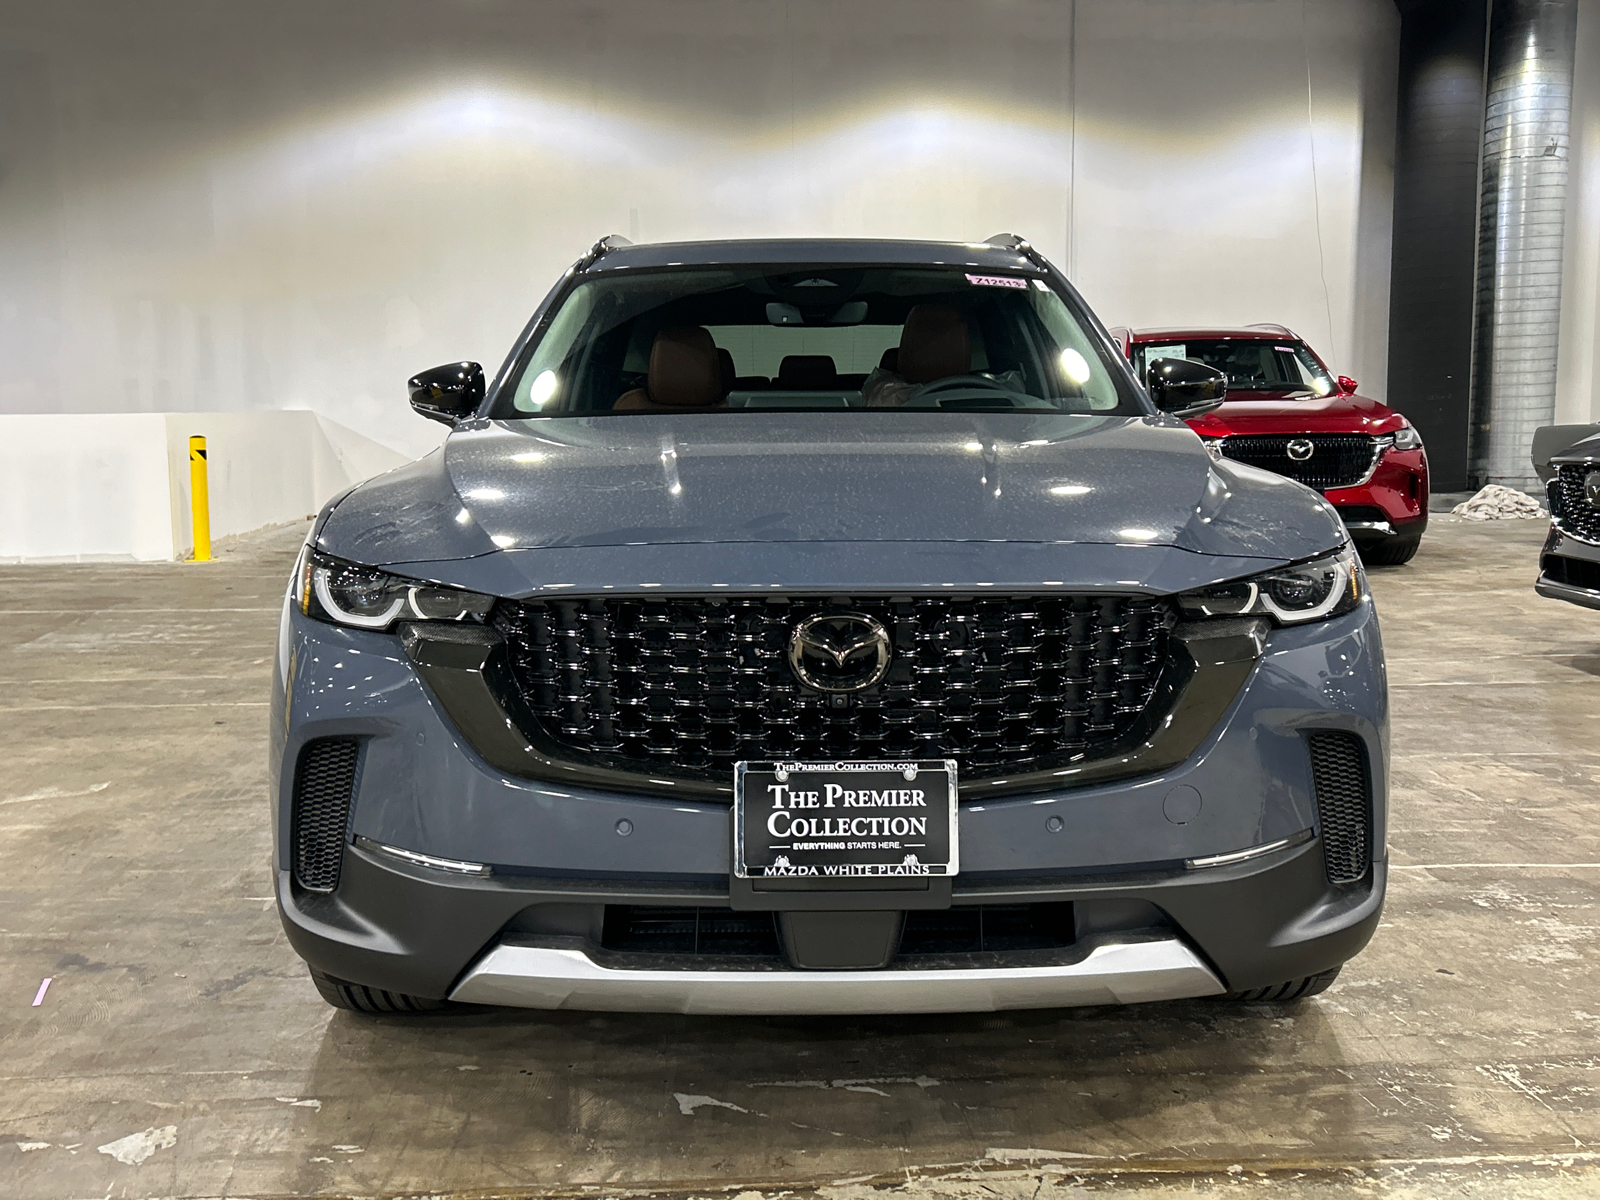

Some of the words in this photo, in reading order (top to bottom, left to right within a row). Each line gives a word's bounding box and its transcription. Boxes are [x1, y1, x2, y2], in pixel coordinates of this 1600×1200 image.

[773, 762, 919, 771] THEPREMIERCOLLECTION.COM
[767, 784, 820, 809] THE
[823, 783, 927, 808] PREMIER
[767, 811, 927, 838] COLLECTION
[793, 842, 846, 850] EVERYTHING
[847, 841, 877, 849] STARTS
[878, 841, 902, 849] HERE.
[764, 865, 819, 876] MAZDA
[823, 865, 872, 876] WHITE
[878, 864, 930, 876] PLAINS
